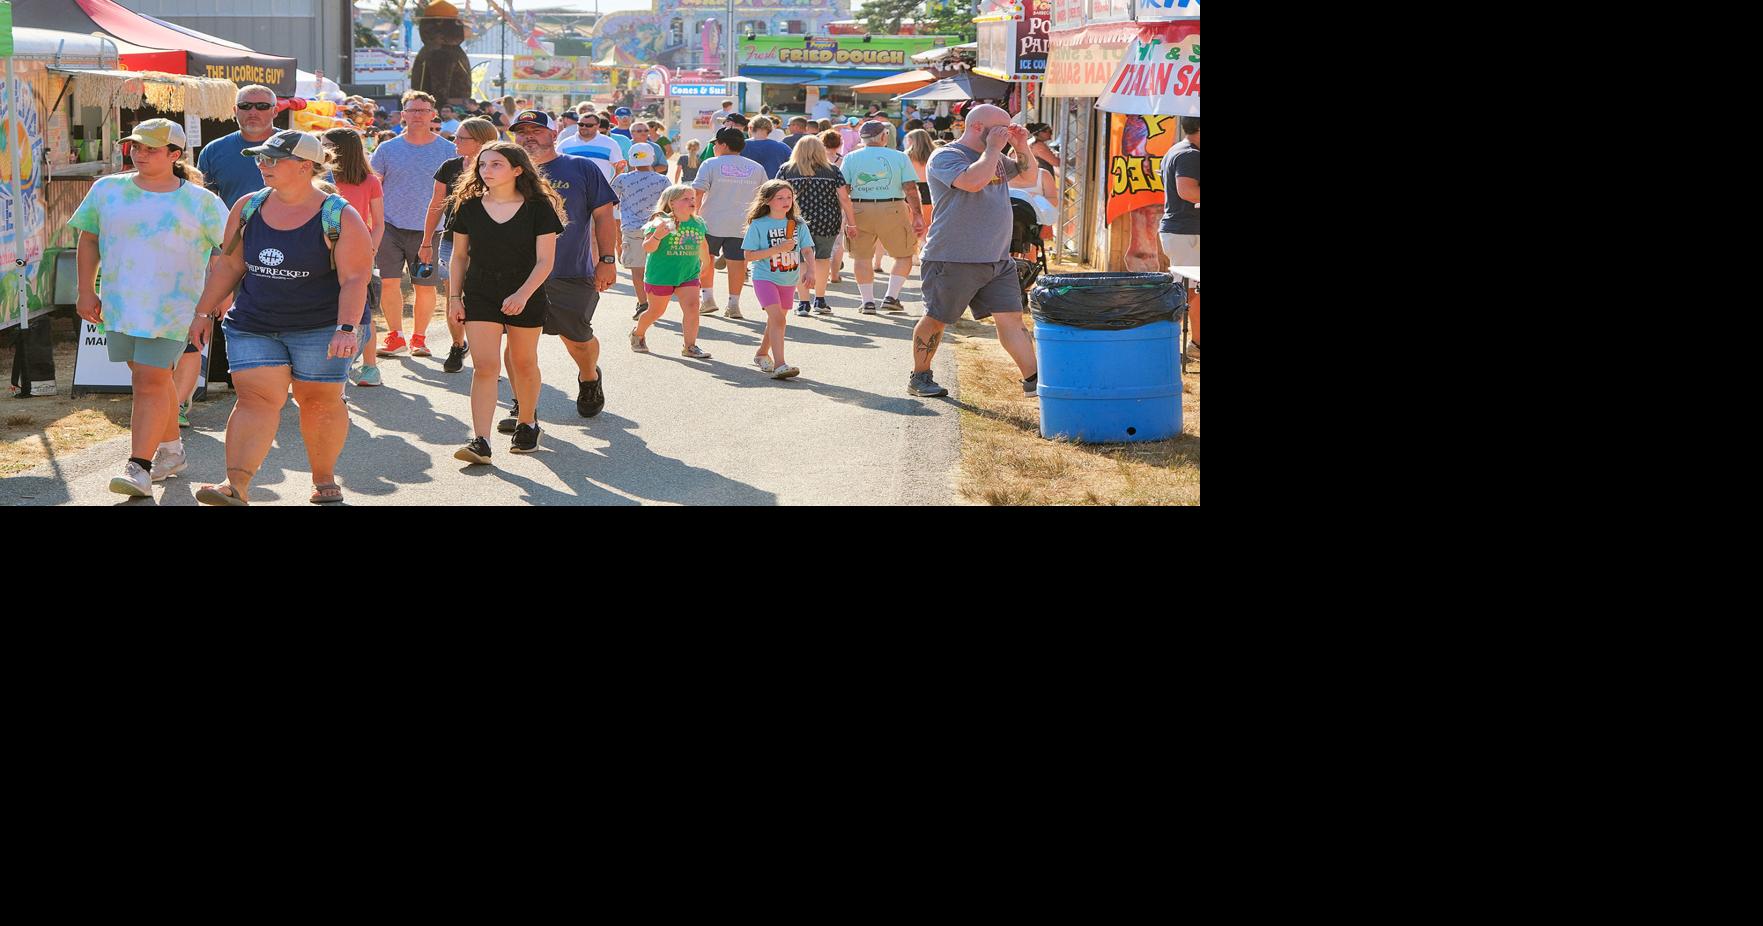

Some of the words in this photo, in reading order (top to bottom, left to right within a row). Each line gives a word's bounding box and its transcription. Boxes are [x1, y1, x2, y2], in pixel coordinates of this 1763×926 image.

[1028, 17, 1051, 35] PO
[779, 47, 835, 63] FRIED
[835, 48, 905, 65] DOUGH
[1165, 47, 1181, 60] &
[1020, 60, 1032, 69] ICE
[206, 65, 225, 78] THE
[226, 65, 264, 83] LICORICE
[671, 86, 698, 95] Cones
[699, 86, 708, 95] &
[769, 227, 798, 238] HEE
[246, 262, 310, 278] HIPWRECKED
